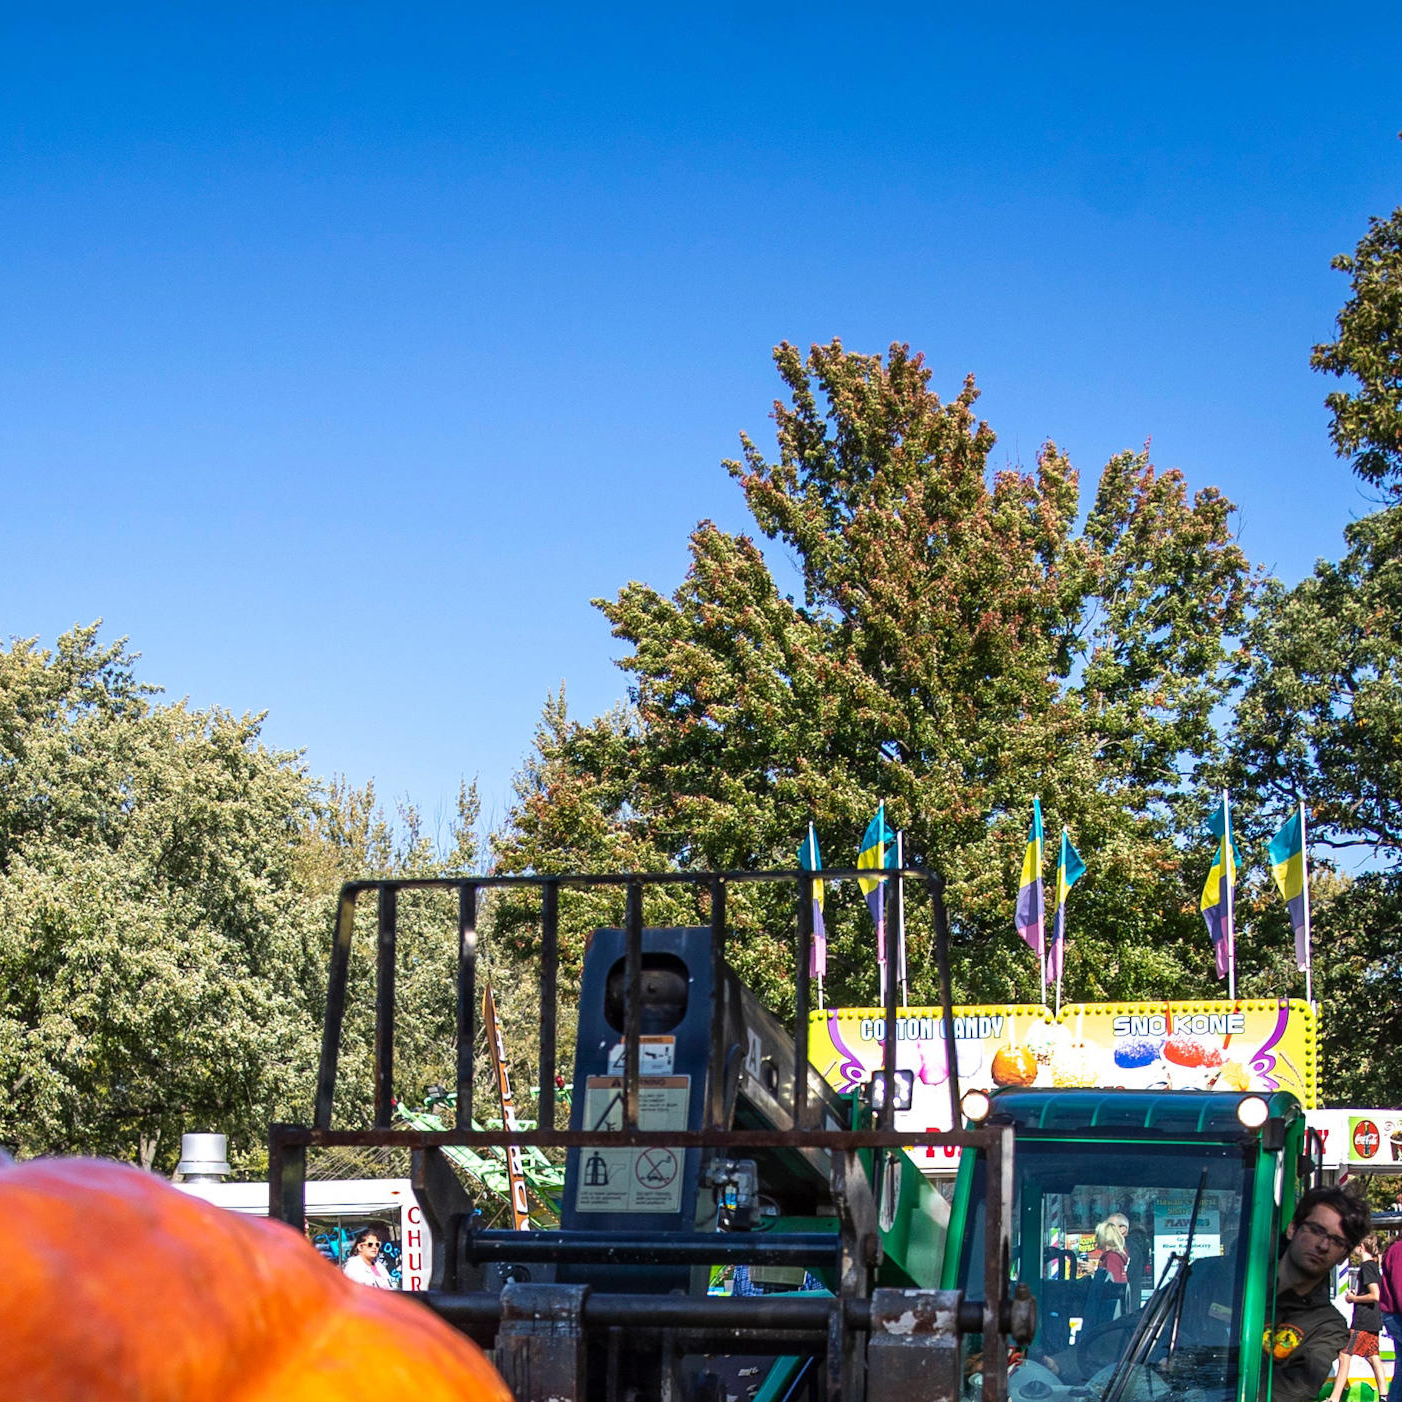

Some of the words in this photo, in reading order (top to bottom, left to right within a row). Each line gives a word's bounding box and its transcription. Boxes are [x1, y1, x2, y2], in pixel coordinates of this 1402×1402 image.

[860, 1017, 933, 1041] COTON
[1113, 1015, 1166, 1036] SNO
[1173, 1013, 1245, 1035] KONE
